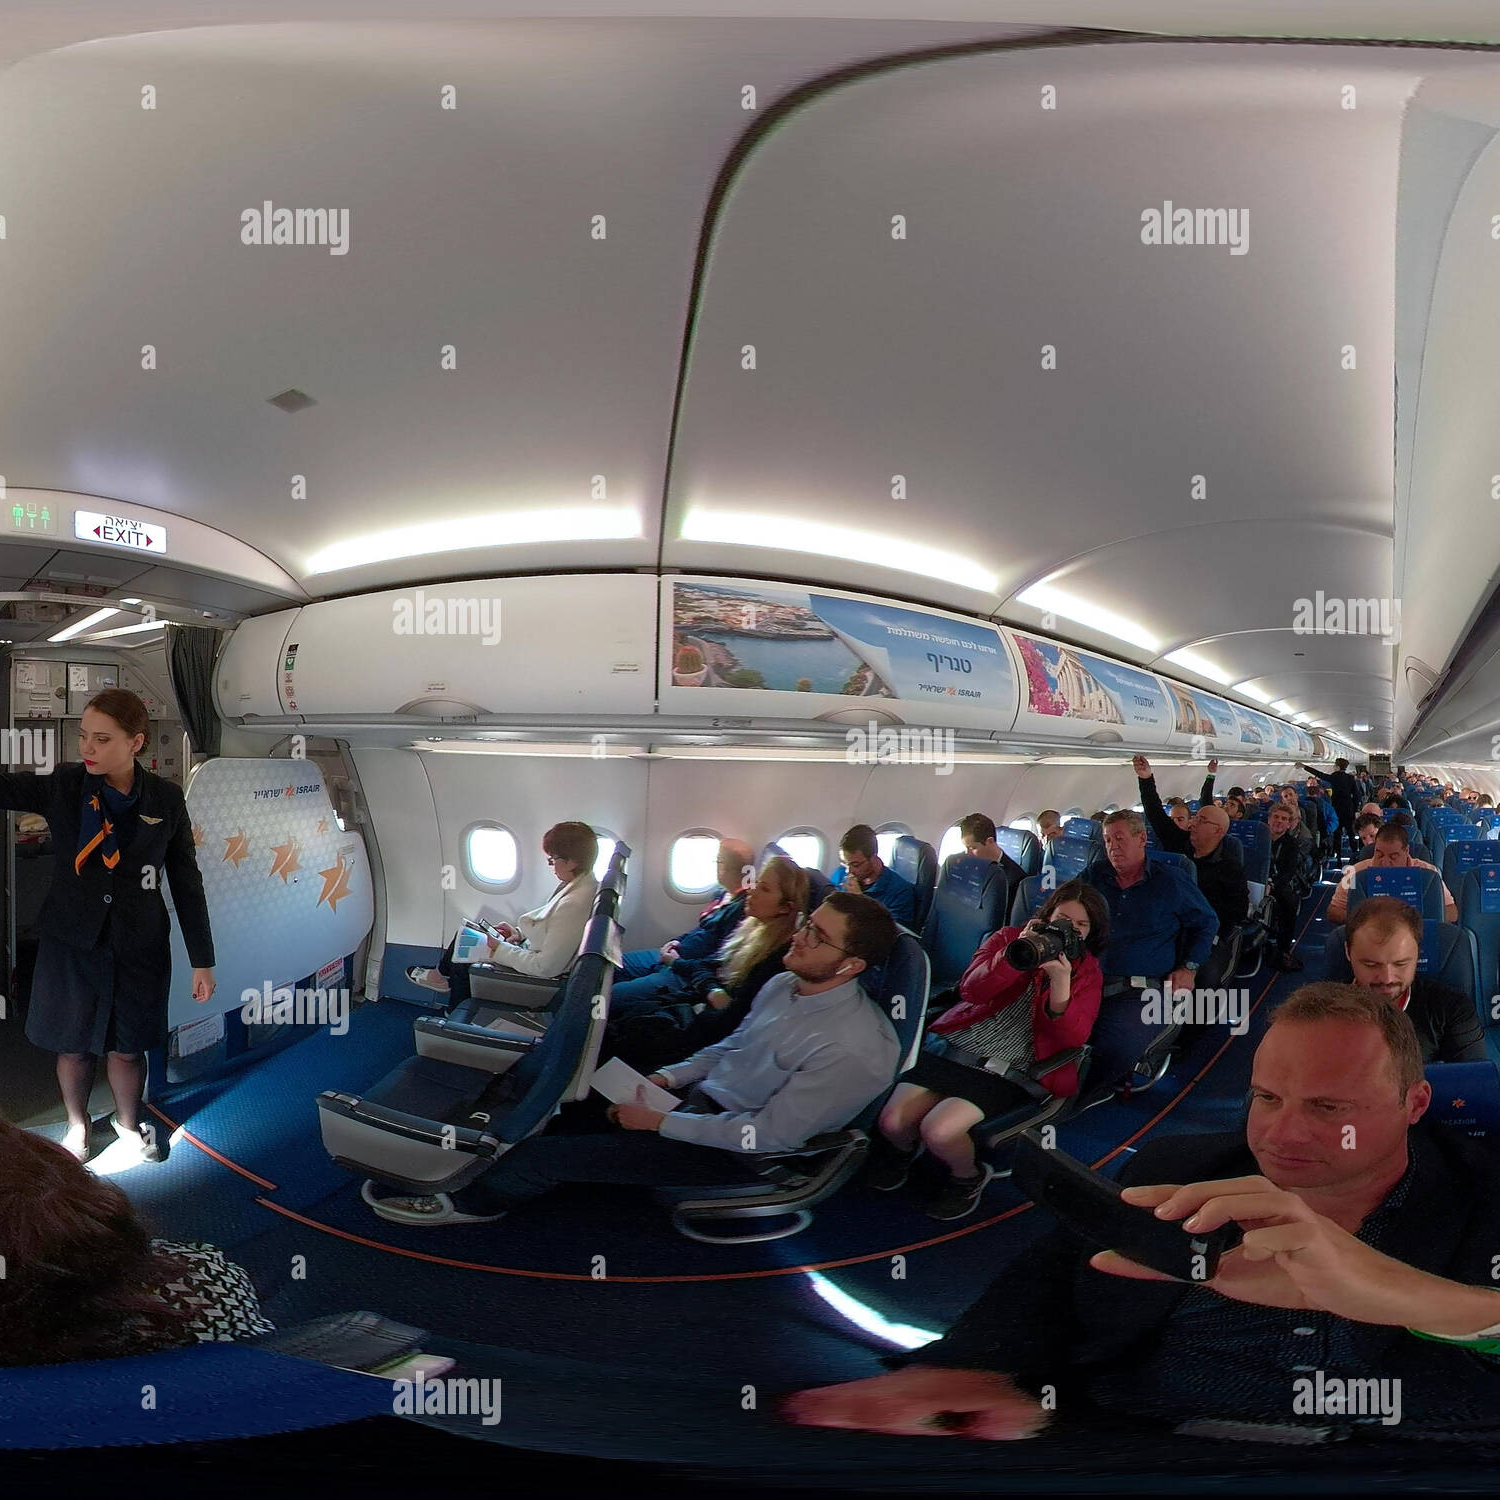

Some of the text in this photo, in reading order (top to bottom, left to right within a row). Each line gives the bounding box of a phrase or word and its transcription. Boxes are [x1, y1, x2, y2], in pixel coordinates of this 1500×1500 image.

[105, 516, 141, 530] יציאה
[103, 526, 143, 546] EXIT
[927, 652, 972, 673] טנריף
[958, 688, 982, 699] ISRAIR
[296, 784, 320, 794] ISRAIR
